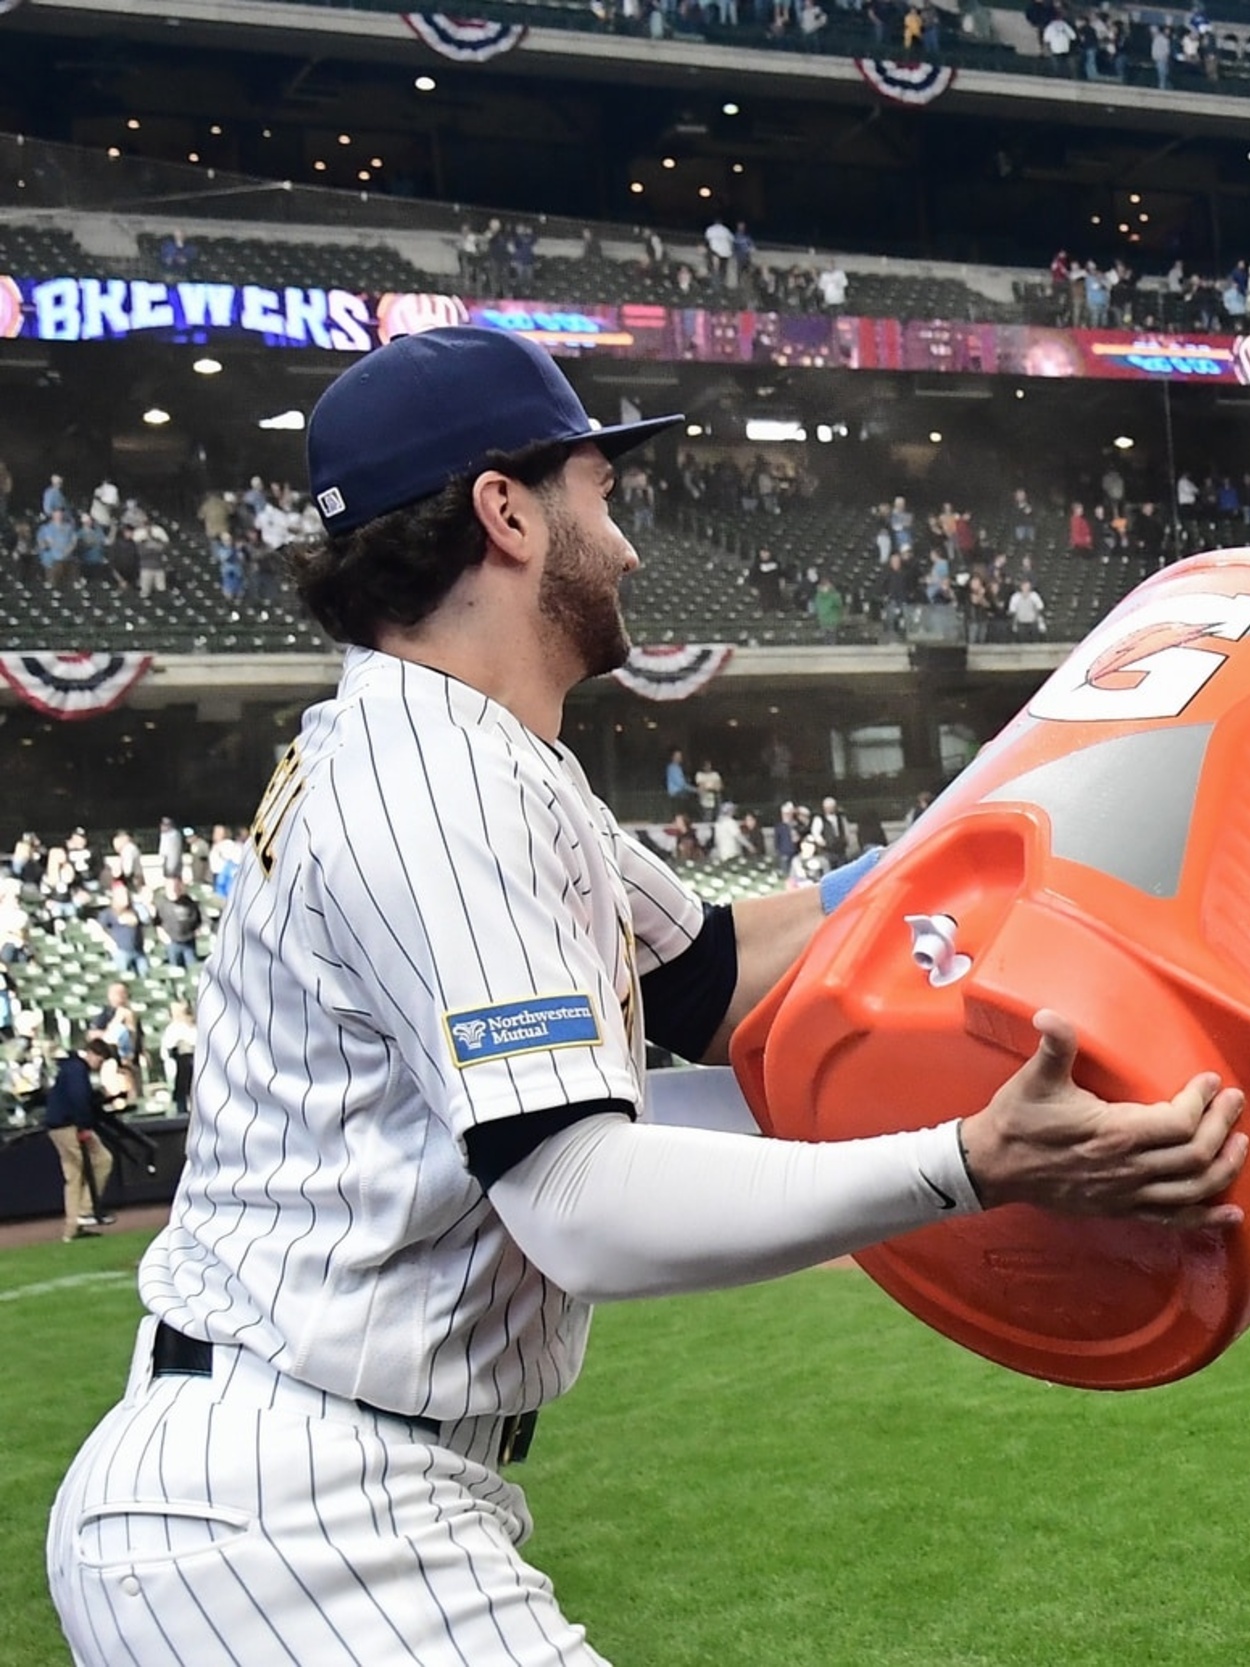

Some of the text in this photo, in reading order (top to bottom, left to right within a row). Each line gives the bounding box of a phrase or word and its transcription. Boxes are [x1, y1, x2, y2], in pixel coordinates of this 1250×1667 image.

[32, 277, 372, 351] BREWERS
[487, 1006, 592, 1031] Northwestern
[492, 1023, 549, 1045] Mutual
